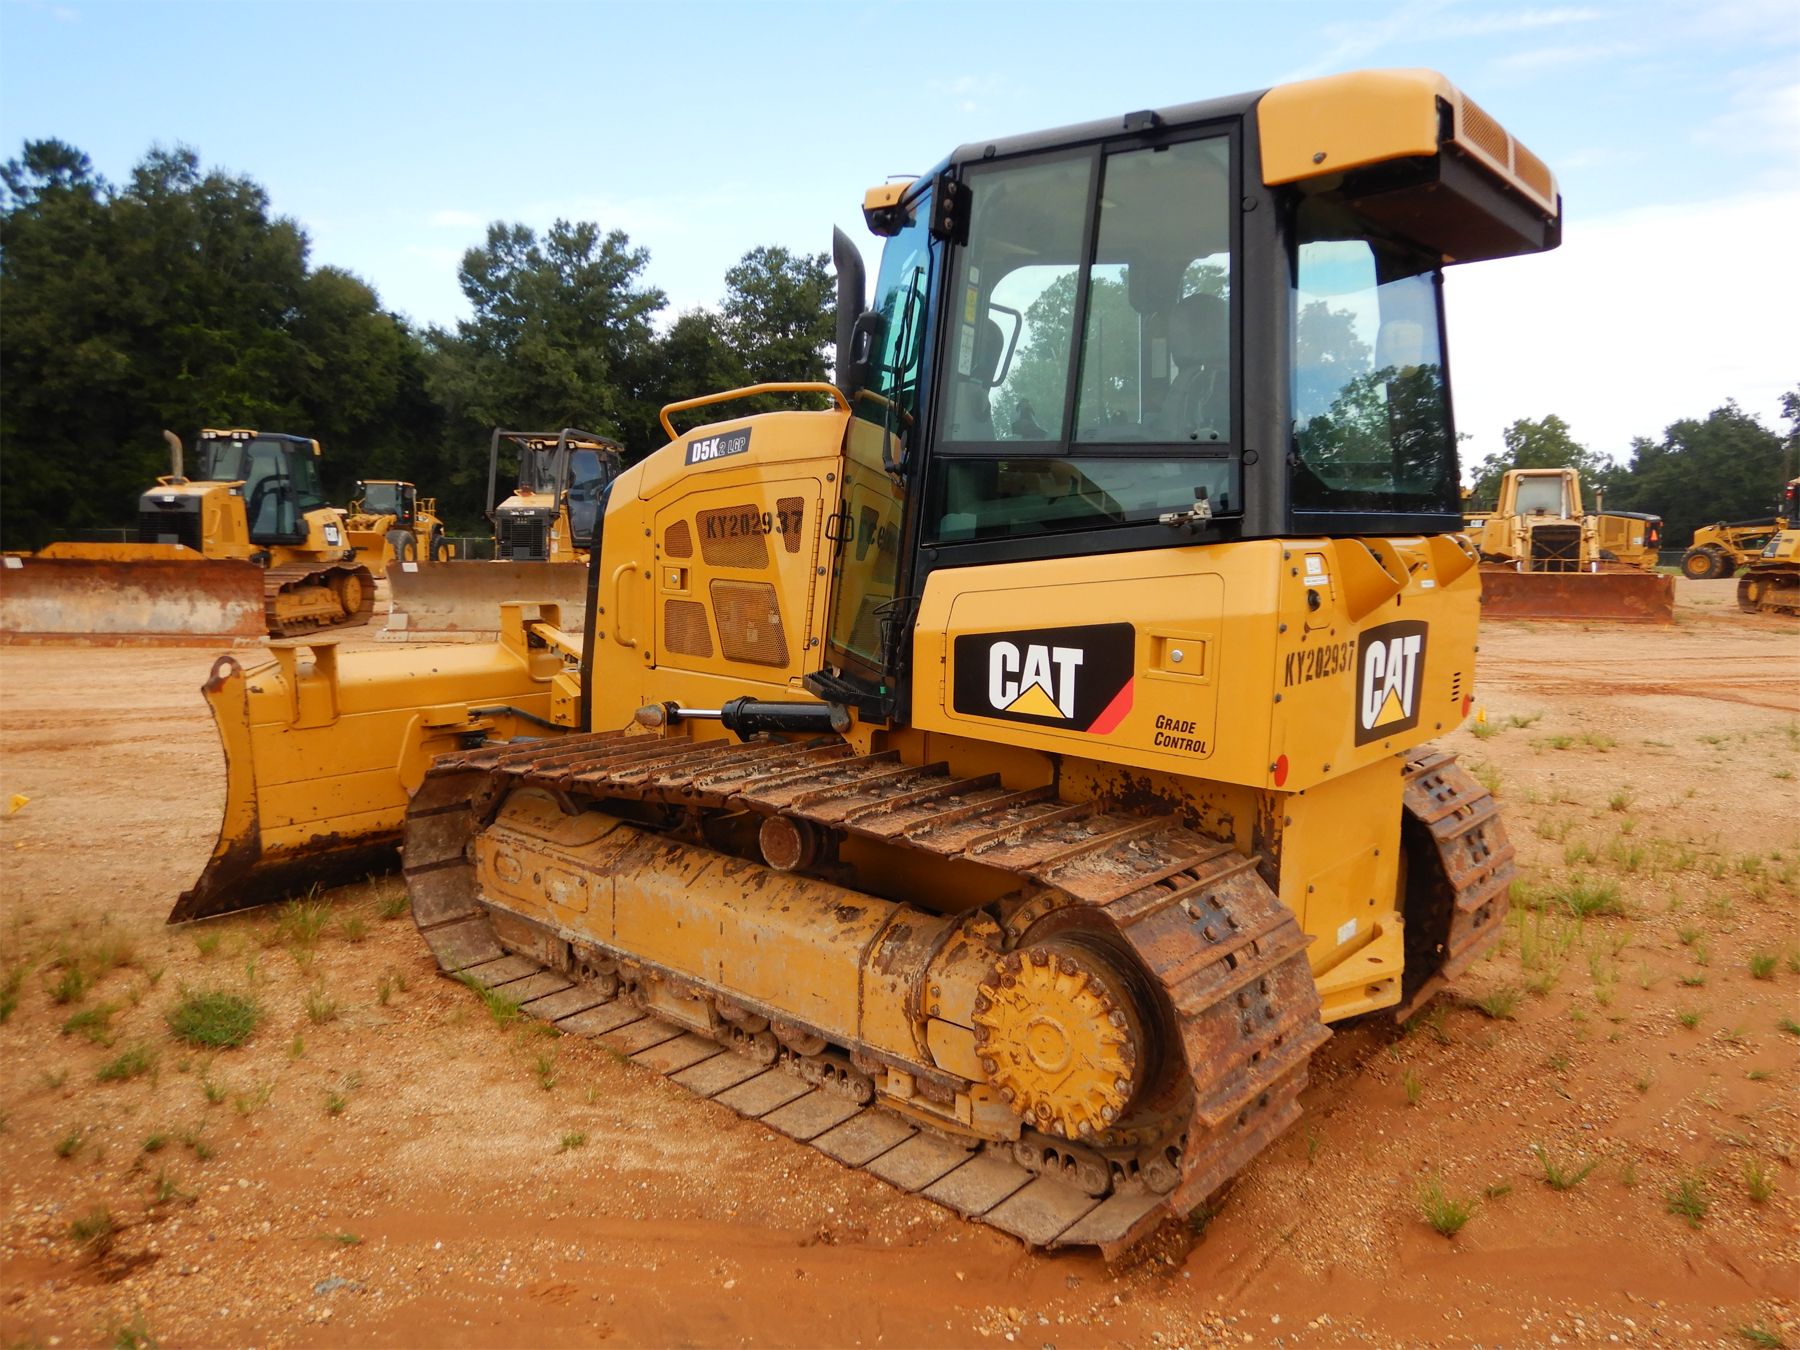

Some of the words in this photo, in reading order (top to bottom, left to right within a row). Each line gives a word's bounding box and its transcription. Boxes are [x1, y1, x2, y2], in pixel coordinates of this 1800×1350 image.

[706, 511, 803, 538] KY202937
[989, 641, 1083, 718] CAT
[1285, 641, 1355, 687] KY202937
[1362, 635, 1421, 730] CAT
[1155, 715, 1196, 734] GRADE
[1154, 732, 1207, 754] CONTROL
